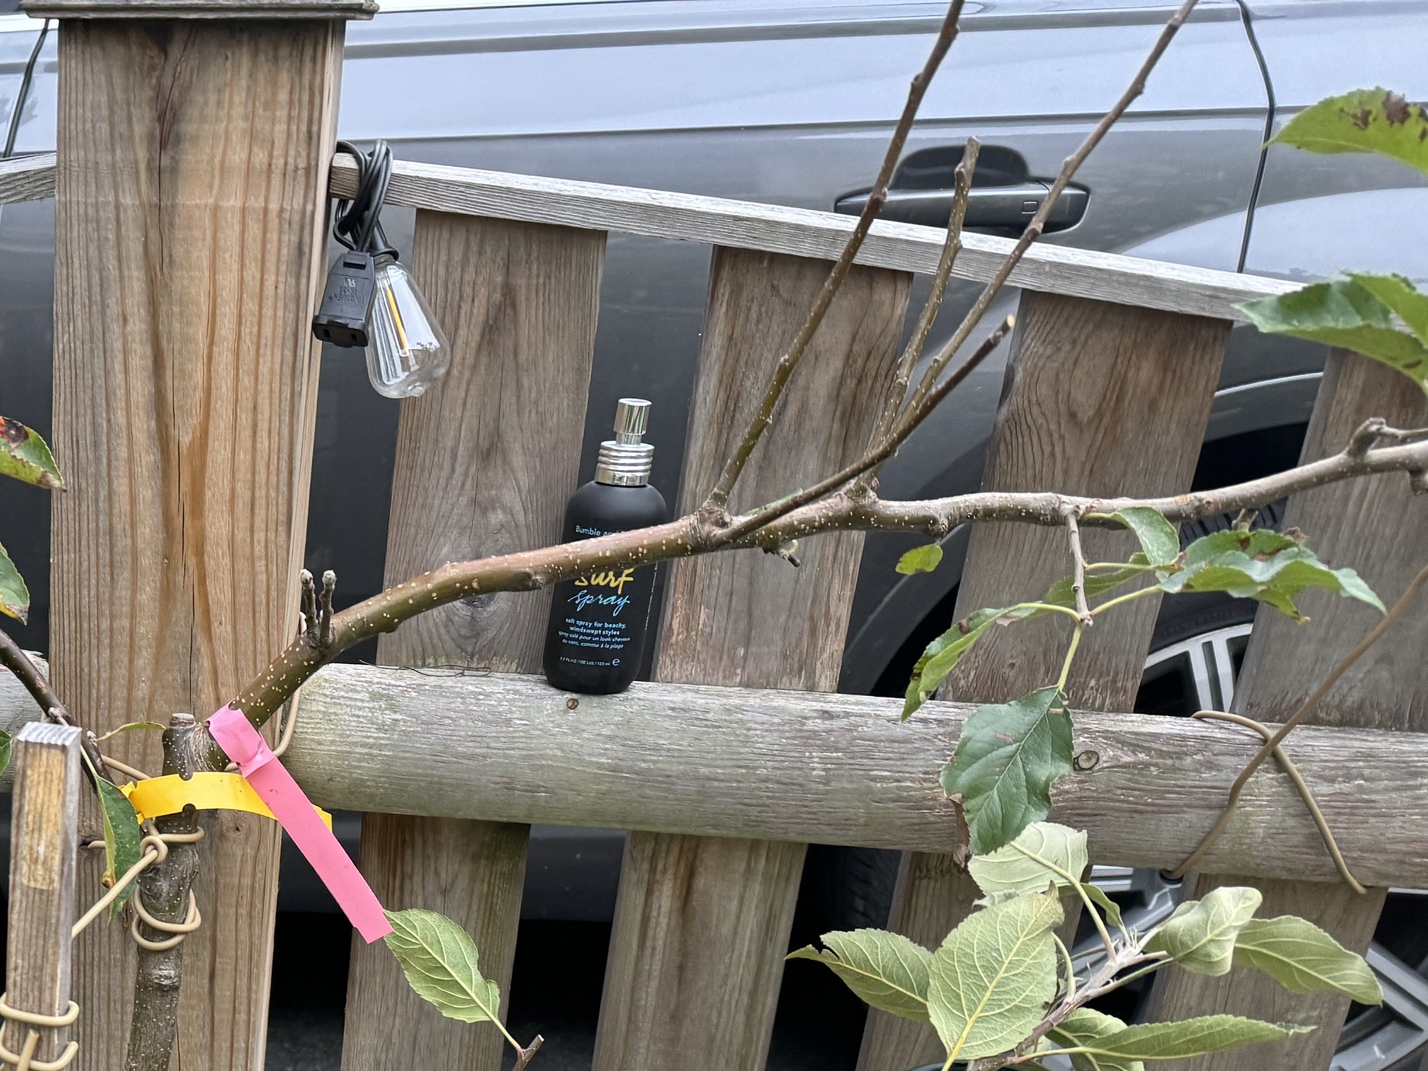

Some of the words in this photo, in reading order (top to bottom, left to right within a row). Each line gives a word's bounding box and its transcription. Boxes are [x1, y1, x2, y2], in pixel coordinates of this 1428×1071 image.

[567, 590, 630, 617] spray
[576, 620, 593, 628] spray
[569, 626, 601, 636] windswept
[602, 629, 620, 637] styles
